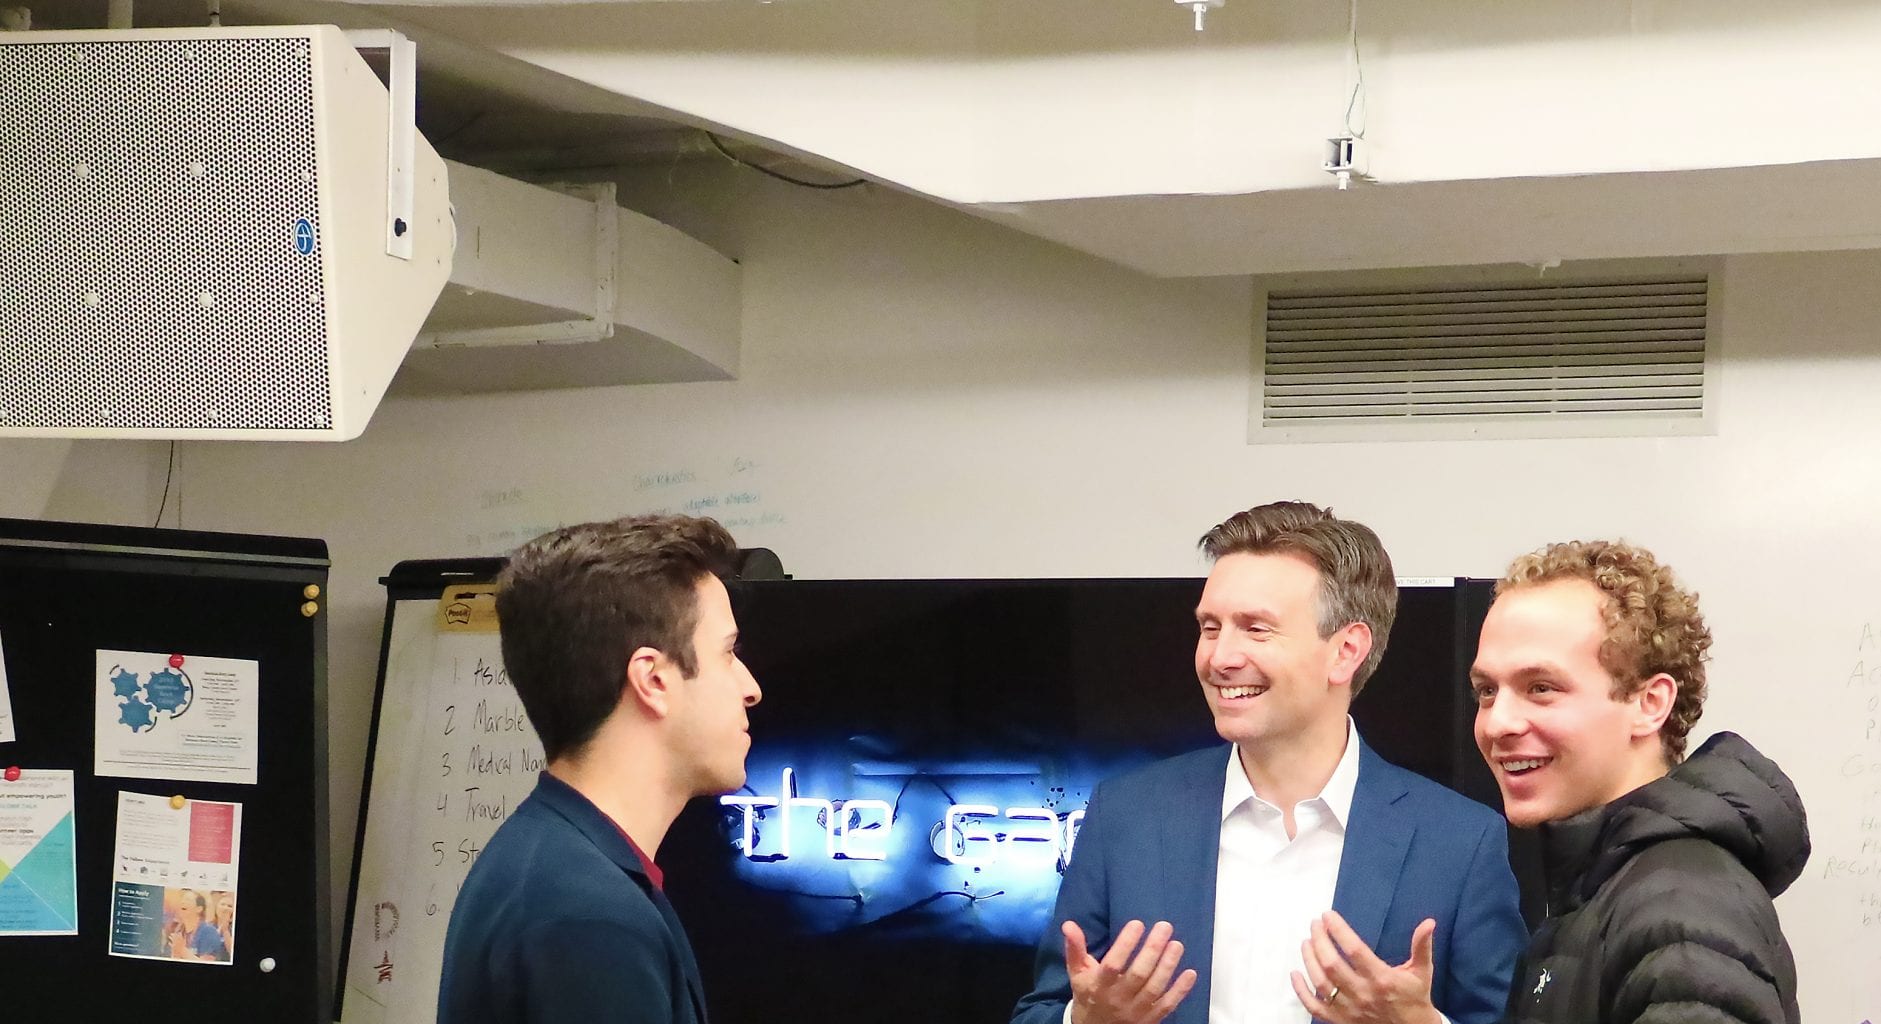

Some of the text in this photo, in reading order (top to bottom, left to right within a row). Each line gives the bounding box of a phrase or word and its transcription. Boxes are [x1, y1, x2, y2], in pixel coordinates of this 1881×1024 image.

[473, 698, 524, 735] Marble
[464, 786, 505, 822] Travel
[431, 841, 445, 868] 5
